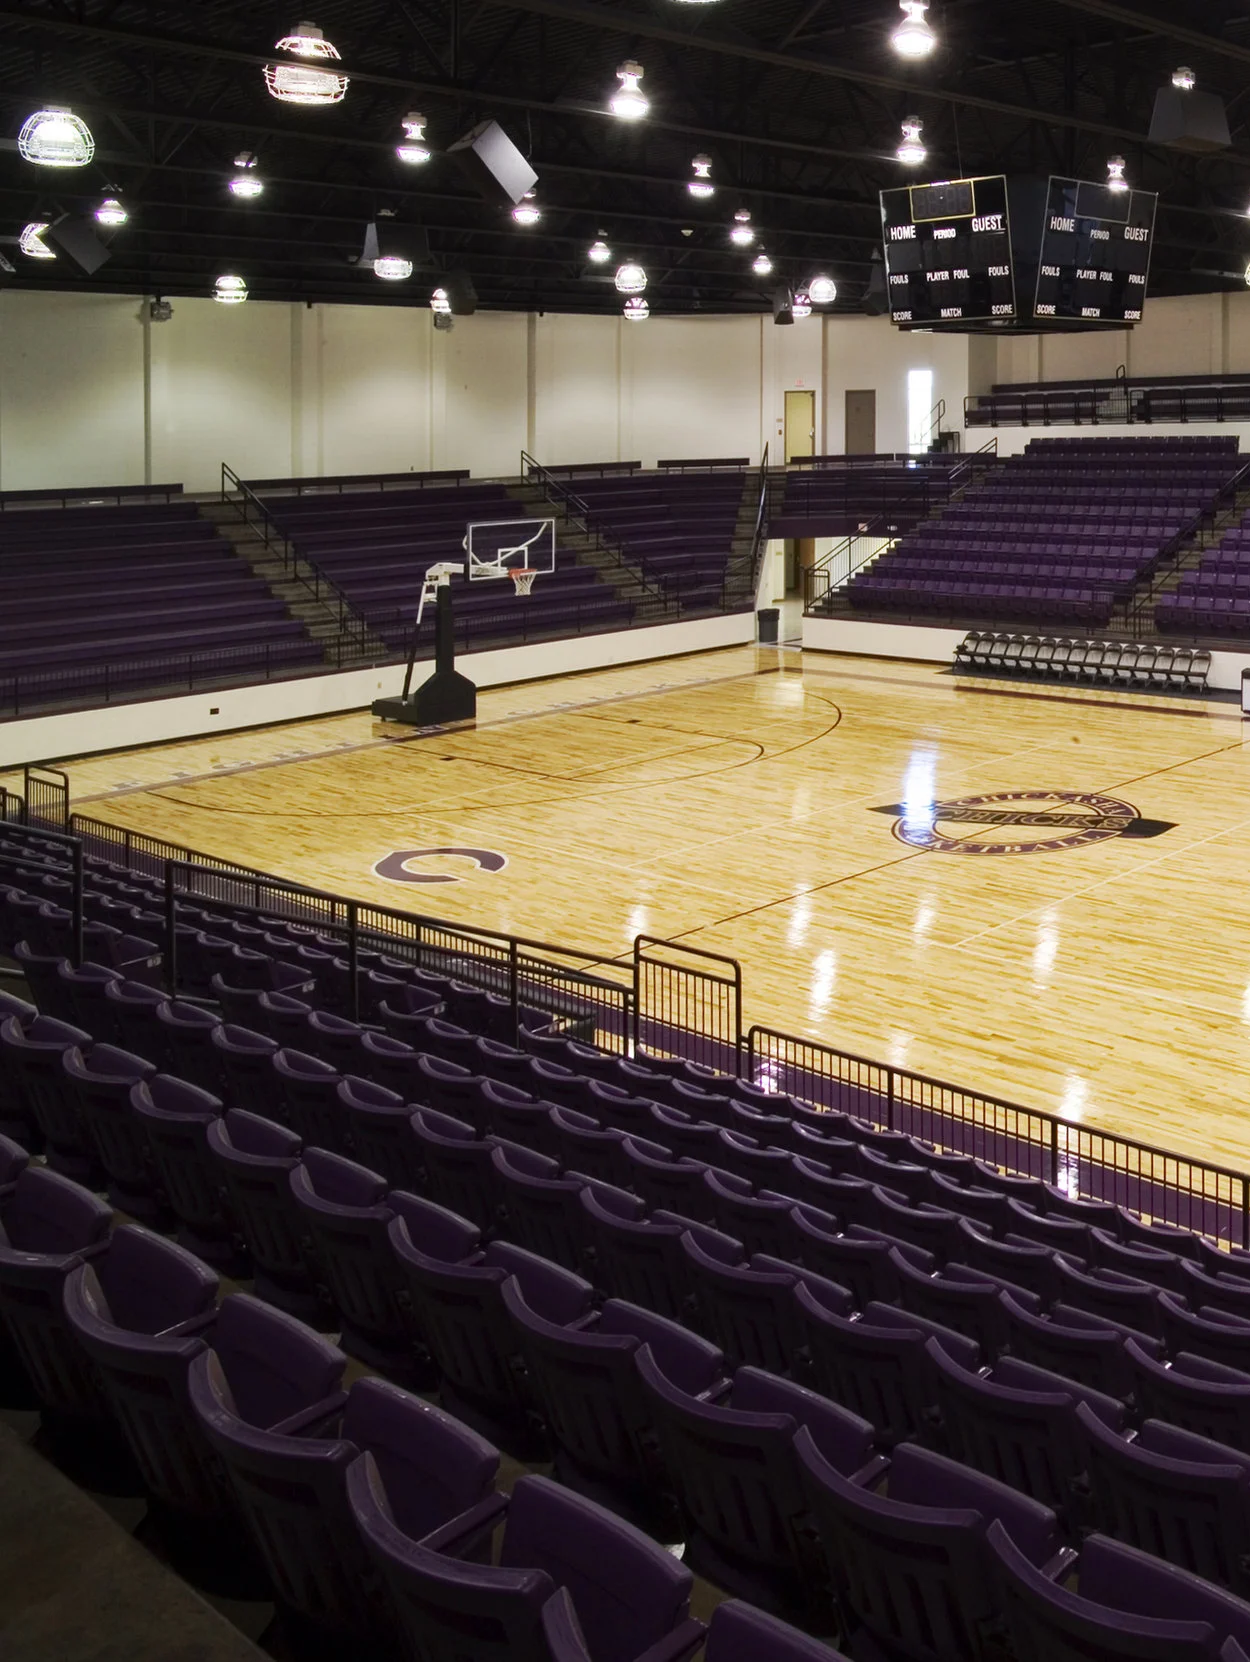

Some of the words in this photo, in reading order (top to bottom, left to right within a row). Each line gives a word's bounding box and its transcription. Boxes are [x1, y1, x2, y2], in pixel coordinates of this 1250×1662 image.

[971, 216, 1003, 232] GUEST
[1050, 216, 1075, 232] HOME
[890, 225, 916, 240] HOME
[933, 228, 956, 239] PERIOD
[1090, 229, 1110, 240] PERIOD
[1124, 226, 1149, 241] GUEST
[926, 270, 949, 282] PLAYER
[953, 269, 970, 279] FOUL
[988, 265, 1009, 276] FOULS
[1041, 266, 1060, 276] FOULS
[1076, 269, 1097, 280] PLAYER
[1100, 271, 1113, 281] FOUL
[890, 274, 909, 285] FOULS
[1128, 274, 1145, 284] FOULS
[941, 308, 962, 318] MATCH
[992, 304, 1013, 315] SCORE
[1037, 304, 1056, 315] SCORE
[1081, 307, 1101, 317] MATCH
[1124, 310, 1141, 320] SCORE
[893, 311, 912, 321] SCORE
